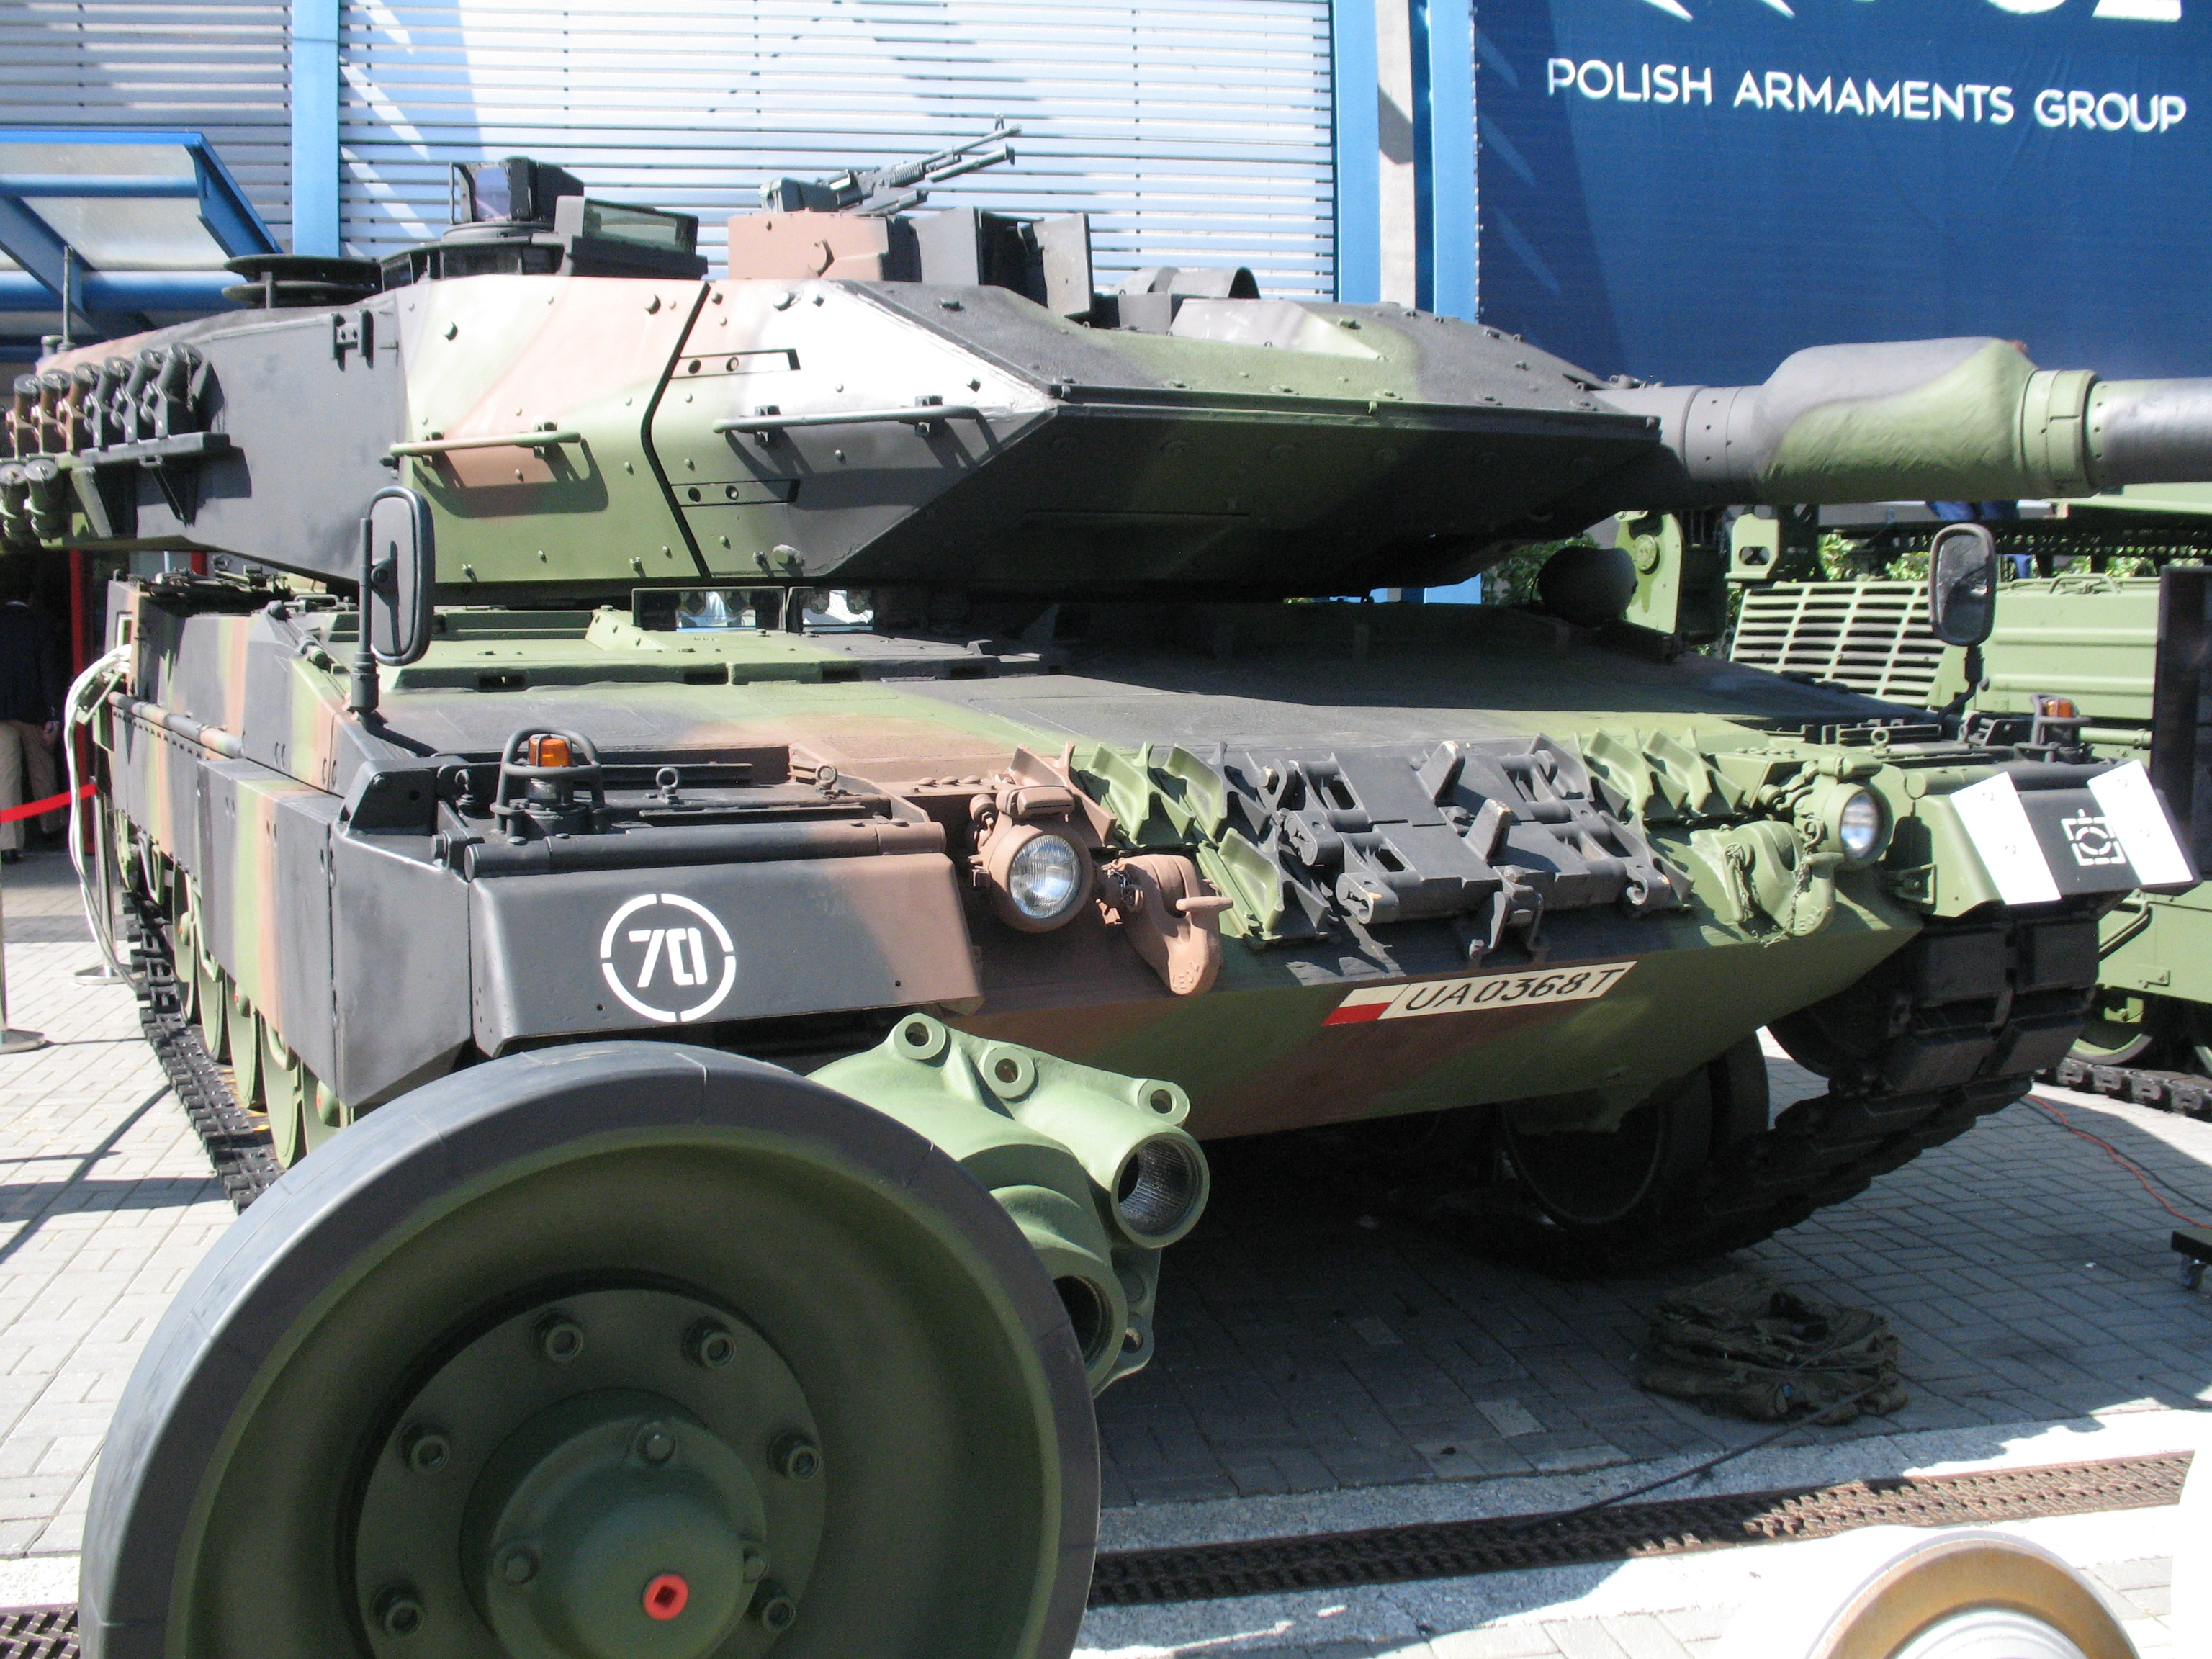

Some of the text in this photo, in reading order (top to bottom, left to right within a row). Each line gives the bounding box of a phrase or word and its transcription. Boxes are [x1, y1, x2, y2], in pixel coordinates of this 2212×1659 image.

[1547, 57, 2188, 133] POLISH ARMAMENTS GROUP
[628, 927, 708, 987] 70
[1406, 968, 1625, 1010] UA0368T
